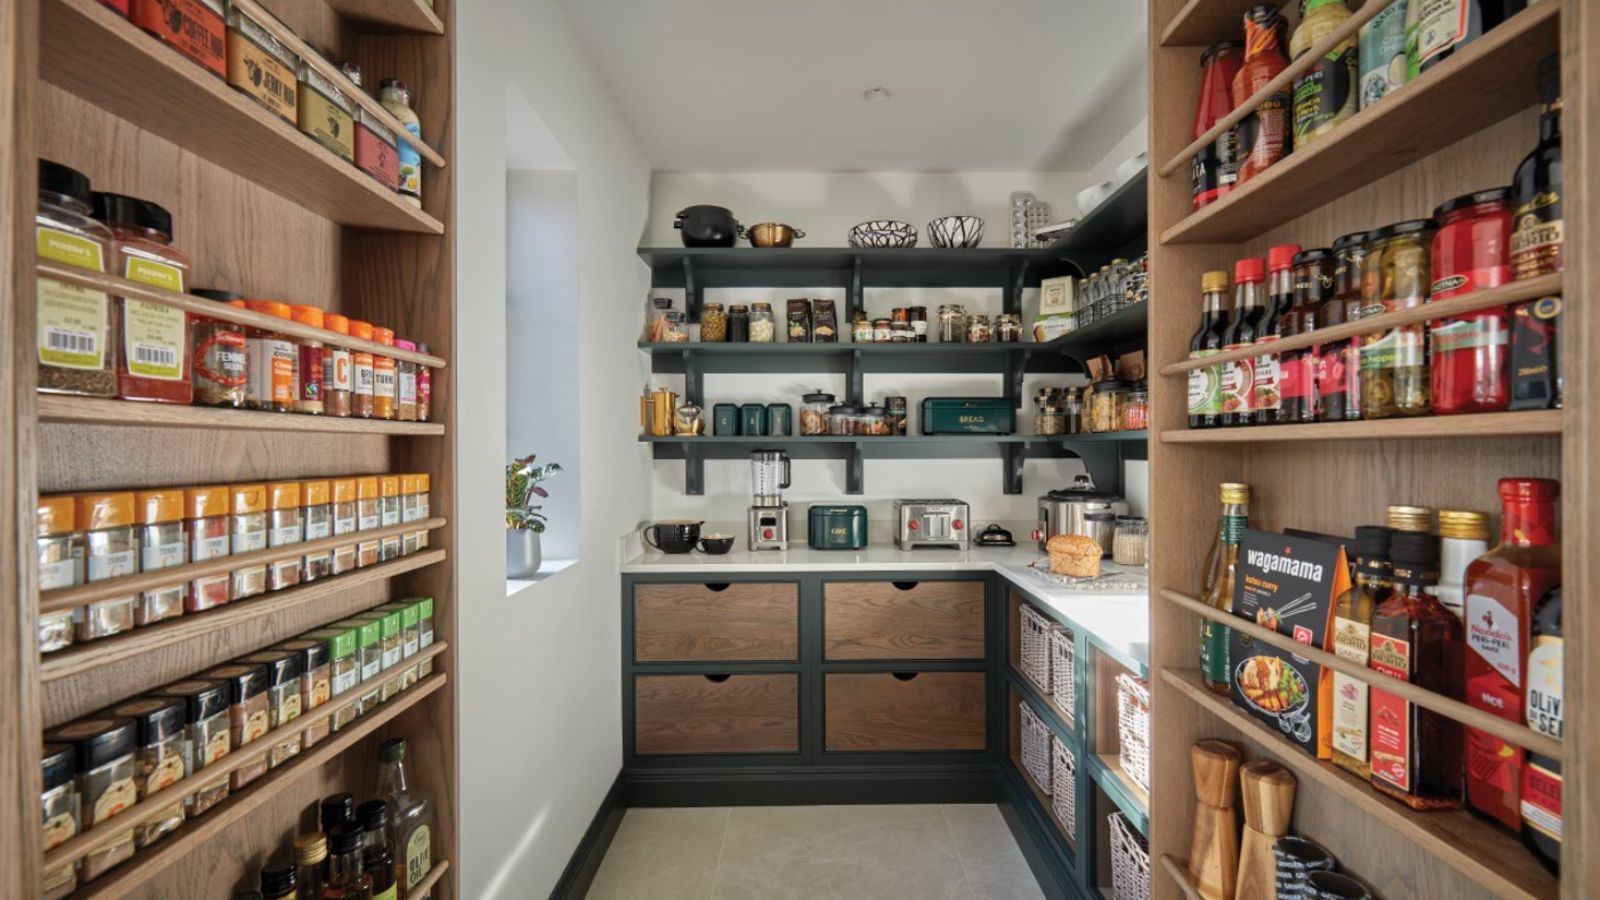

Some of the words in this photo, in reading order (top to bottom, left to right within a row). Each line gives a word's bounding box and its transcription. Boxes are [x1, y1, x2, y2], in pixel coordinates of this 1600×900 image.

[959, 415, 984, 423] BREAD
[1247, 549, 1323, 582] wagamama
[410, 848, 428, 872] OLIVE
[410, 867, 421, 884] OIL
